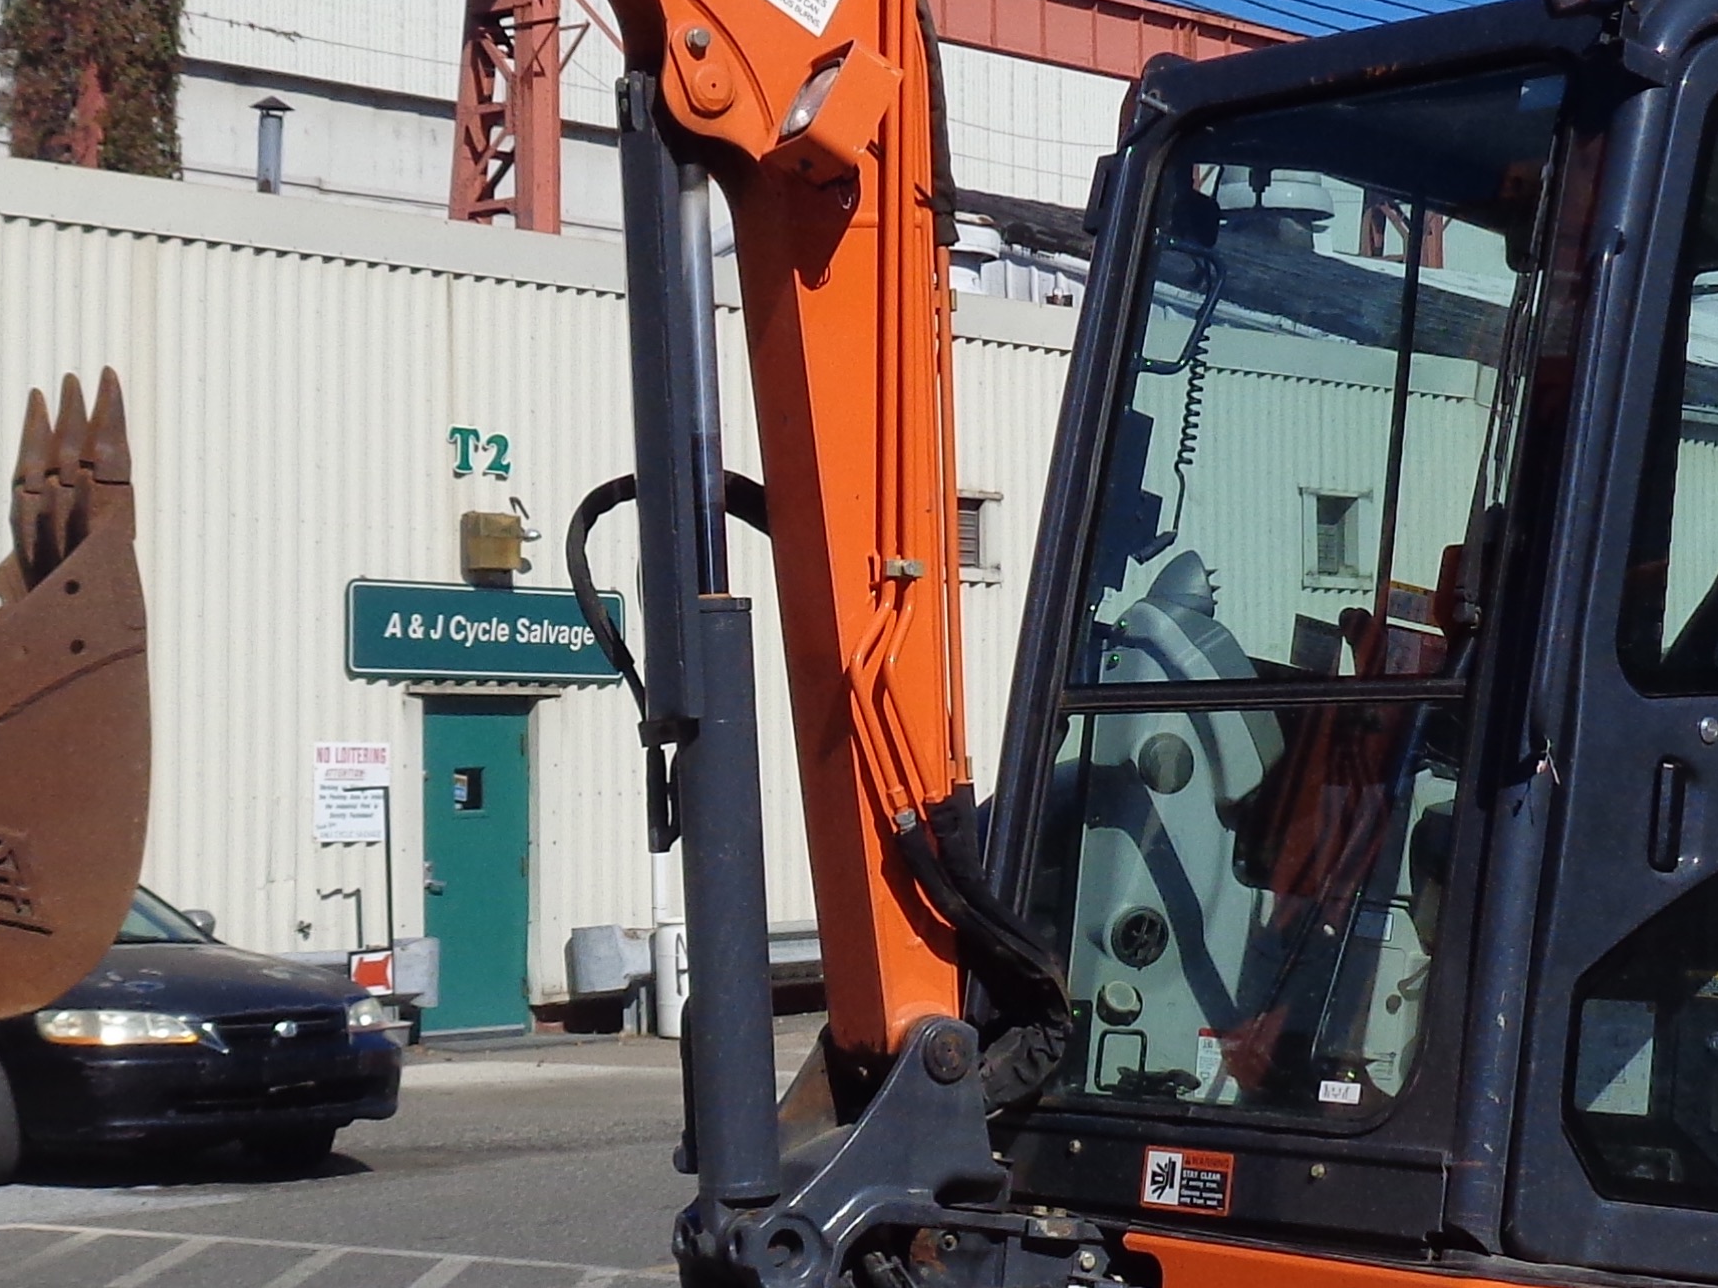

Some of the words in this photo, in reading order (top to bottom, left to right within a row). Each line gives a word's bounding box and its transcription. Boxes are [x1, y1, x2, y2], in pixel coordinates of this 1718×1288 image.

[447, 425, 511, 478] T2
[384, 612, 402, 638] A
[408, 614, 424, 639] &
[430, 615, 444, 639] J
[449, 615, 509, 647] Cycle
[516, 618, 595, 651] Salvage
[316, 747, 331, 764] NO
[335, 747, 387, 764] LOITERING
[1182, 1169, 1198, 1178] STAY
[1200, 1171, 1220, 1181] CLEAR
